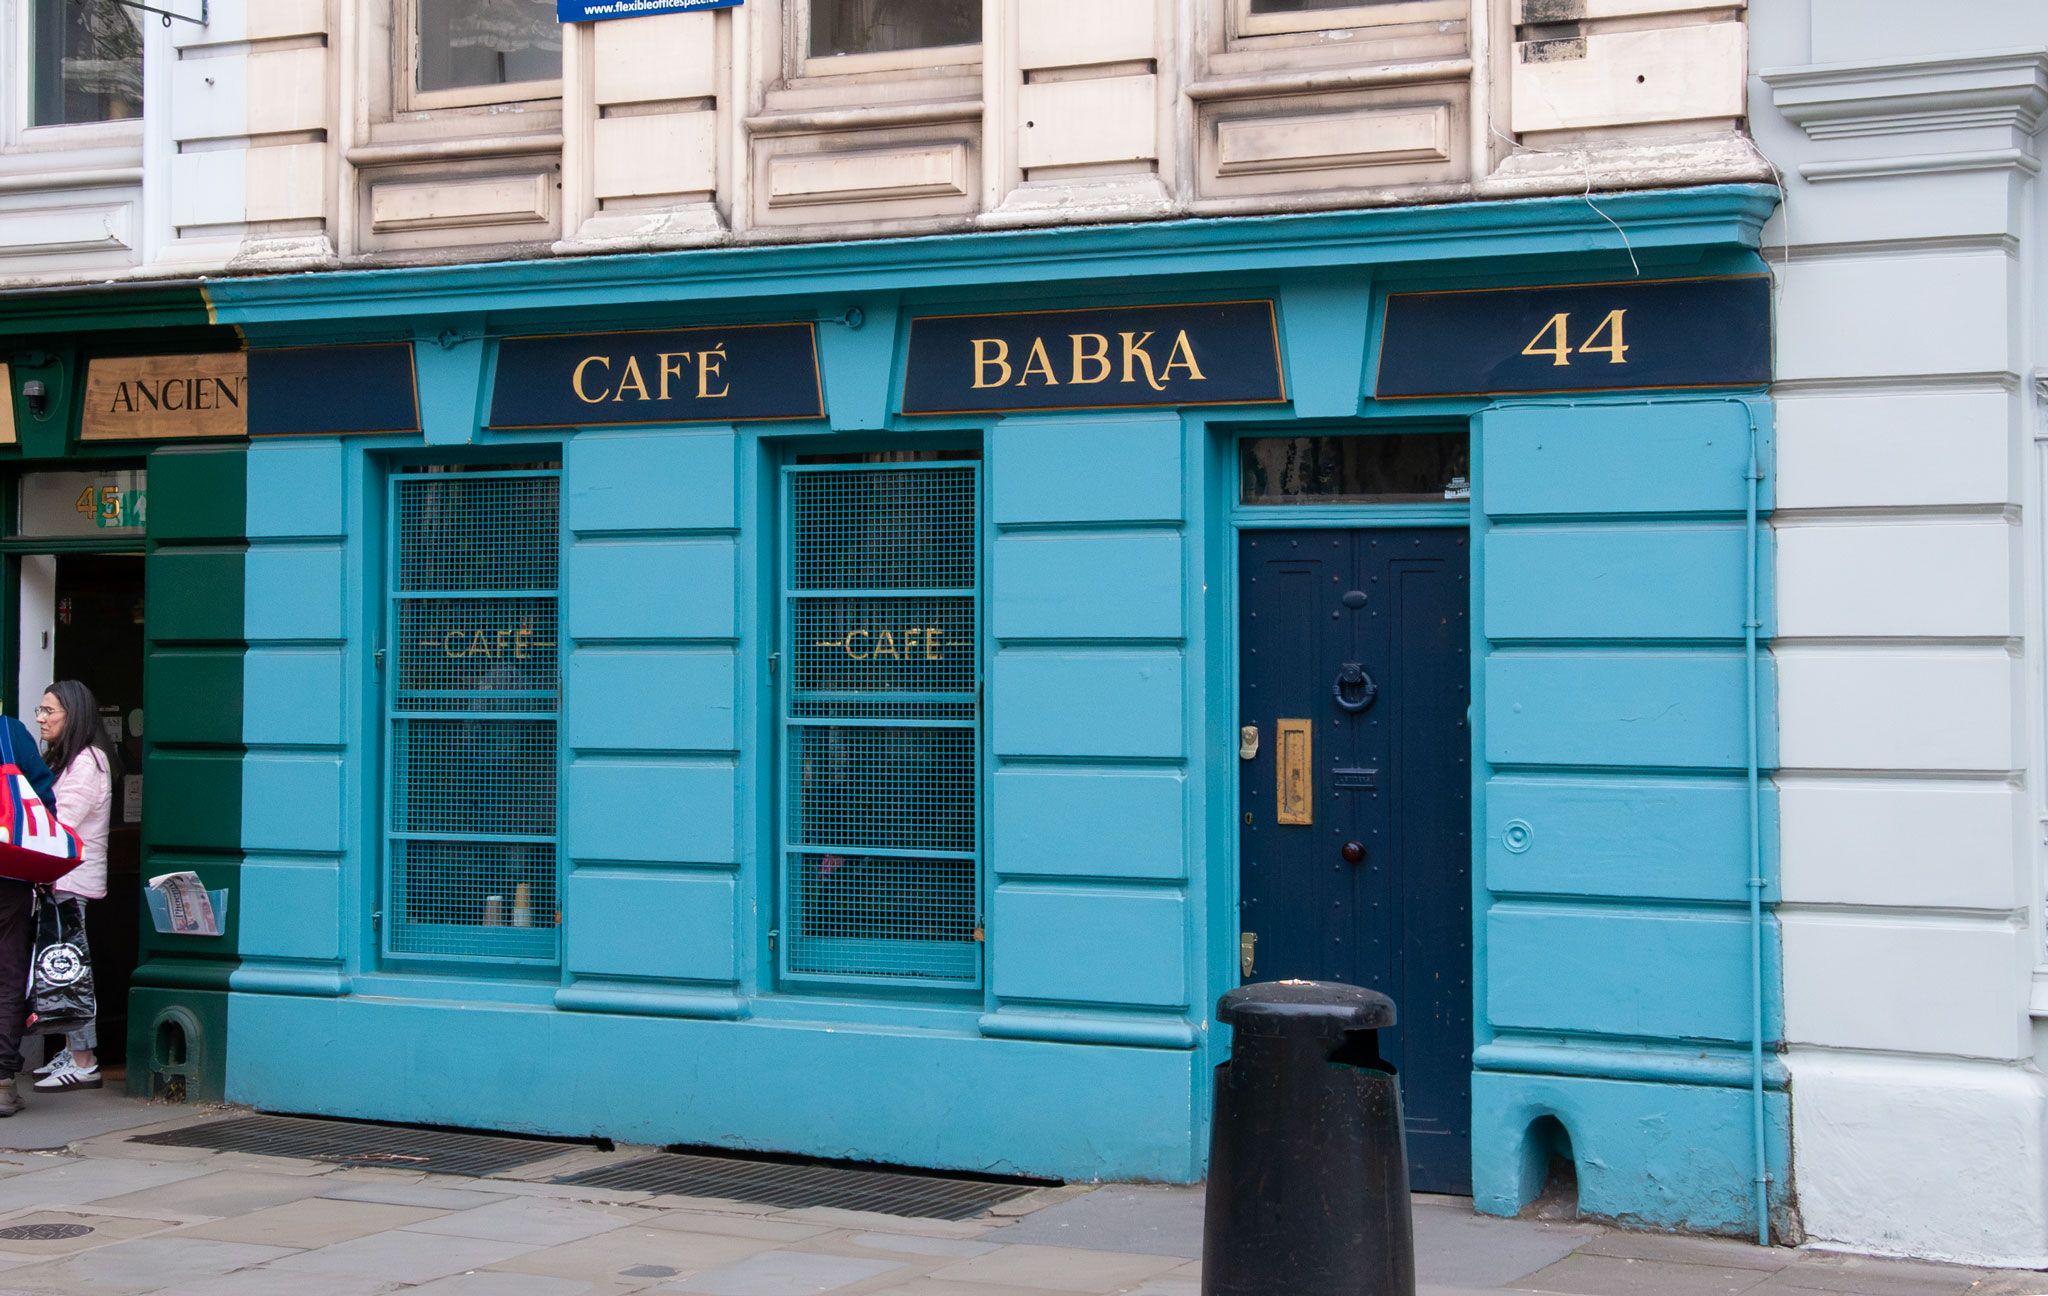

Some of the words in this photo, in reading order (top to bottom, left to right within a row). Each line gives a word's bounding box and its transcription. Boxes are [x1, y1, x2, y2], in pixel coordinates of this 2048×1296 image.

[970, 329, 1207, 391] BABKA
[1521, 309, 1629, 366] 44
[572, 342, 730, 404] CAFÉ
[75, 485, 121, 519] 45
